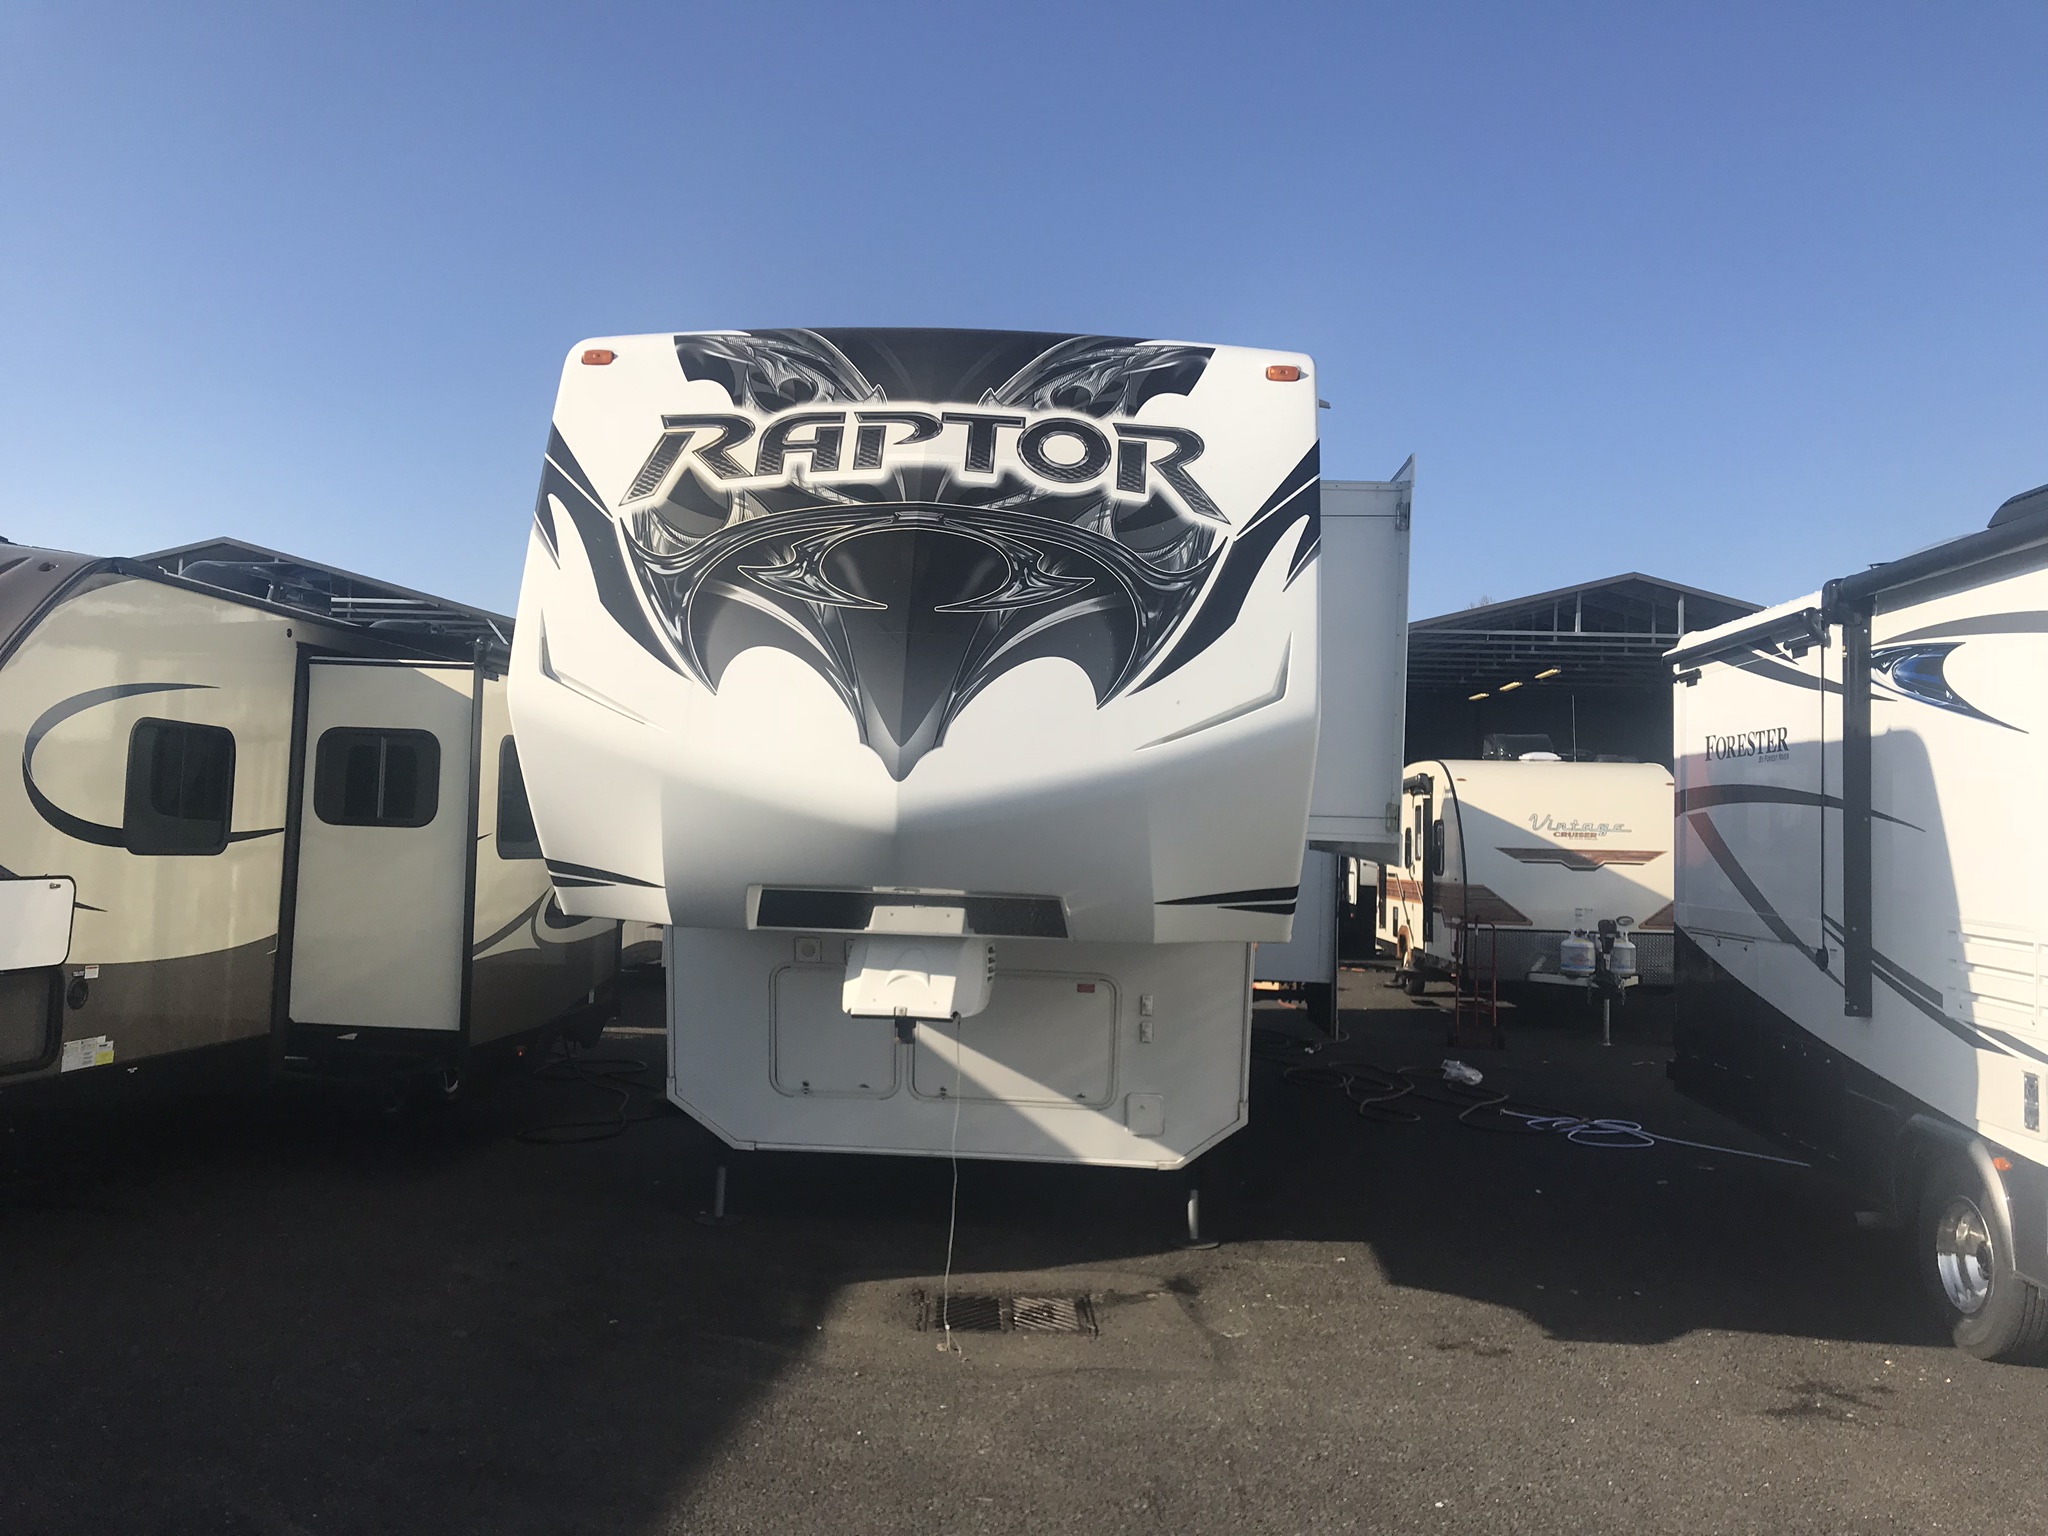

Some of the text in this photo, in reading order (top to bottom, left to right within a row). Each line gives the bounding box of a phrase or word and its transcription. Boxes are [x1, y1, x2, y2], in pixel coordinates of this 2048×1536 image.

[618, 410, 1232, 526] RAPTOR
[1705, 727, 1789, 762] FORESTER
[1528, 813, 1632, 837] Vintage
[1553, 831, 1598, 839] CRUISER
